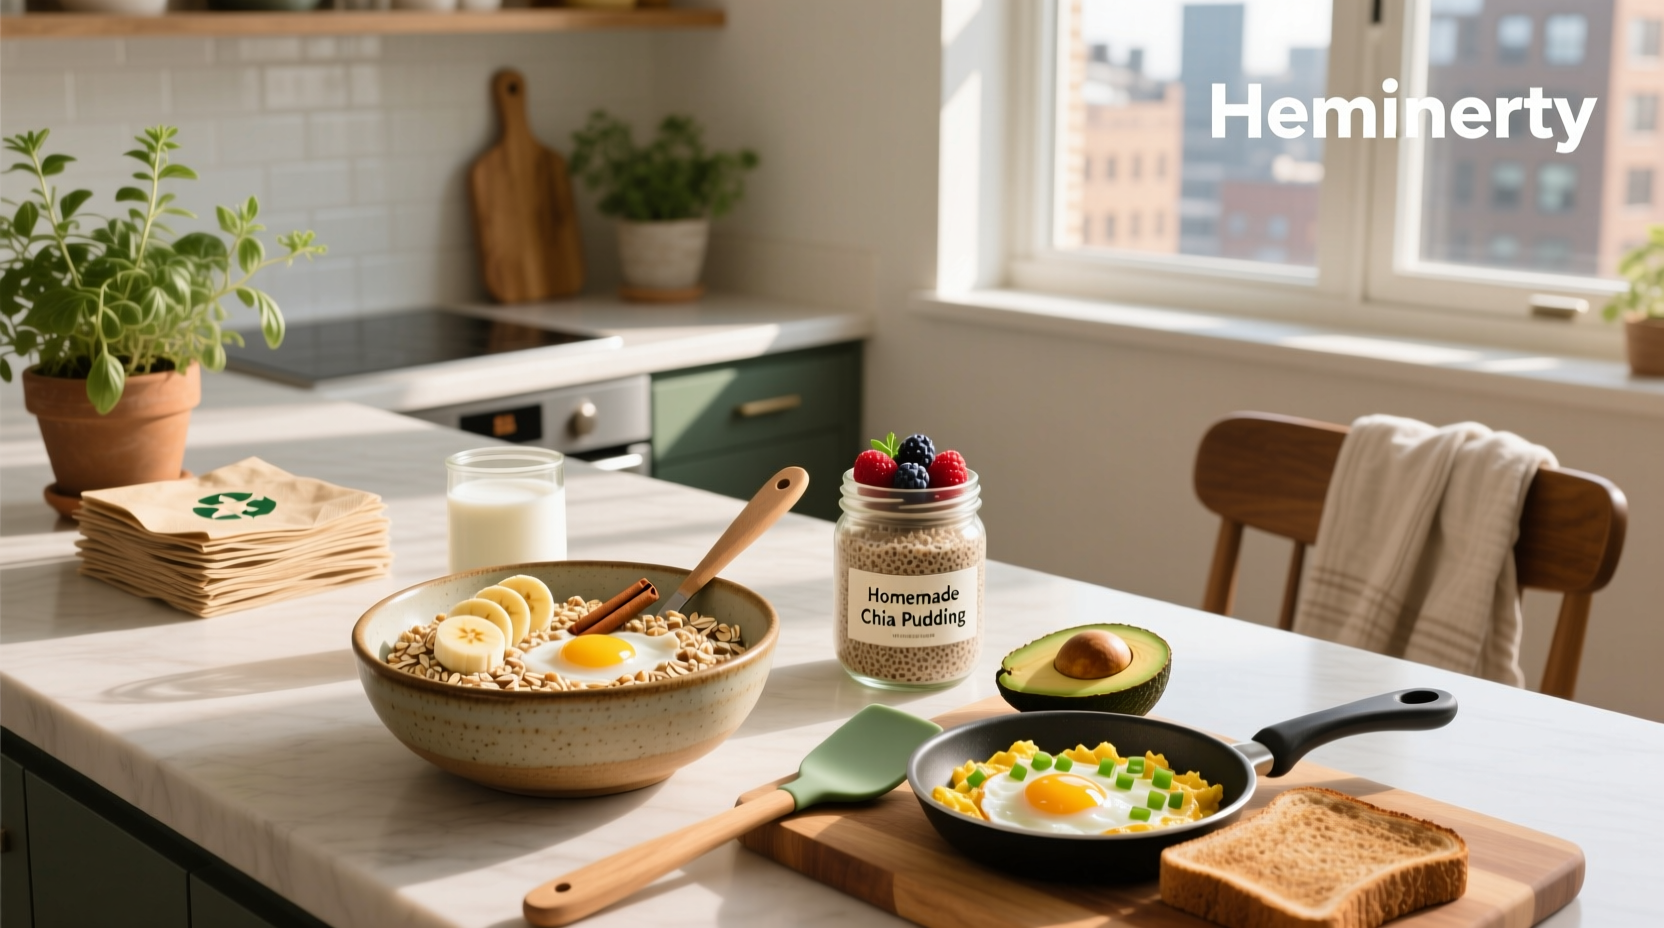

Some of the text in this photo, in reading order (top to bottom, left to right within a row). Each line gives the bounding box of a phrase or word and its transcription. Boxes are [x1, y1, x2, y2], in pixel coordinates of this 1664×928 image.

[868, 585, 960, 605] Homemade
[861, 608, 966, 628] Chia Pudding
